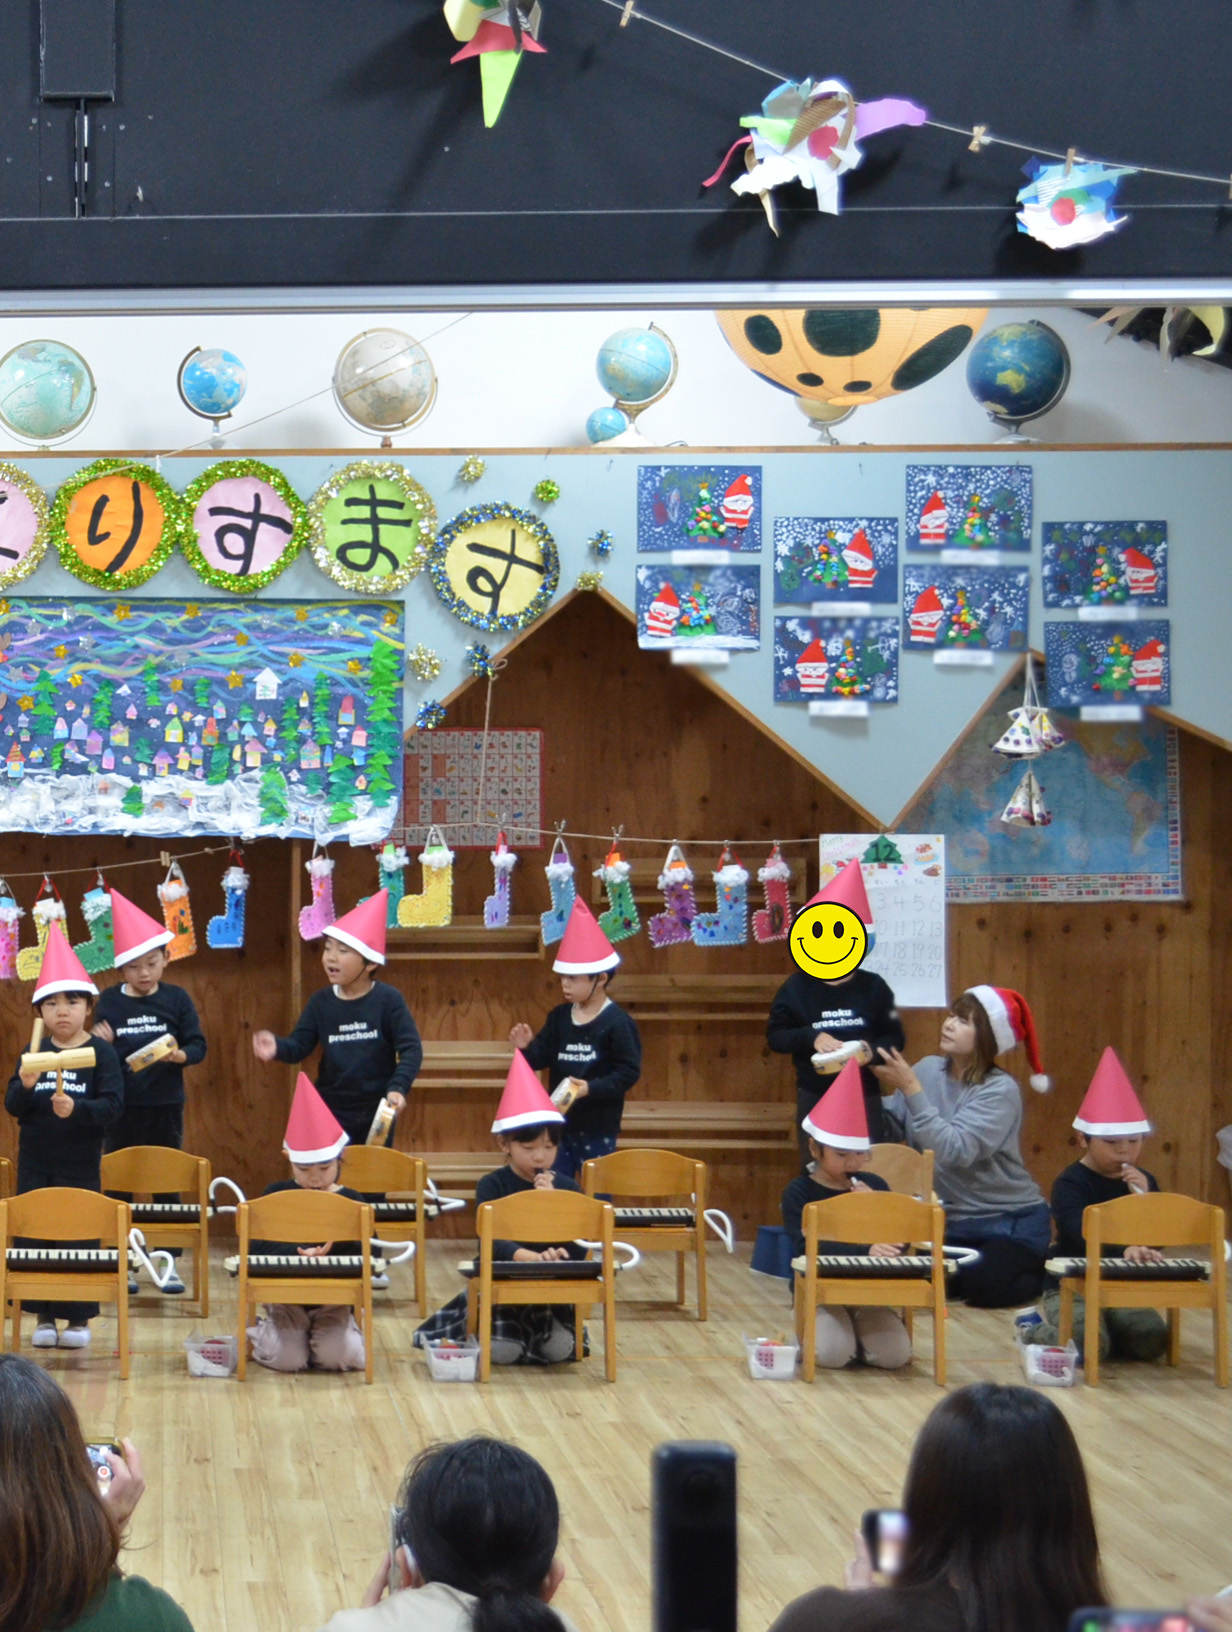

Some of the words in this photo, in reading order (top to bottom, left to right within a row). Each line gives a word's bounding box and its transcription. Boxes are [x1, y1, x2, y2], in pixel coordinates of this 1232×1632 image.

[871, 843, 896, 862] 12
[876, 892, 887, 910] 3
[894, 895, 907, 910] 4
[913, 893, 925, 911] 5
[929, 895, 941, 912] 6
[127, 1014, 157, 1025] moku
[821, 1008, 852, 1018] moku
[116, 1022, 167, 1037] preschool
[339, 1021, 367, 1032] moku
[328, 1029, 378, 1044] preschool
[47, 1069, 77, 1080] mku
[35, 1080, 86, 1093] preshool
